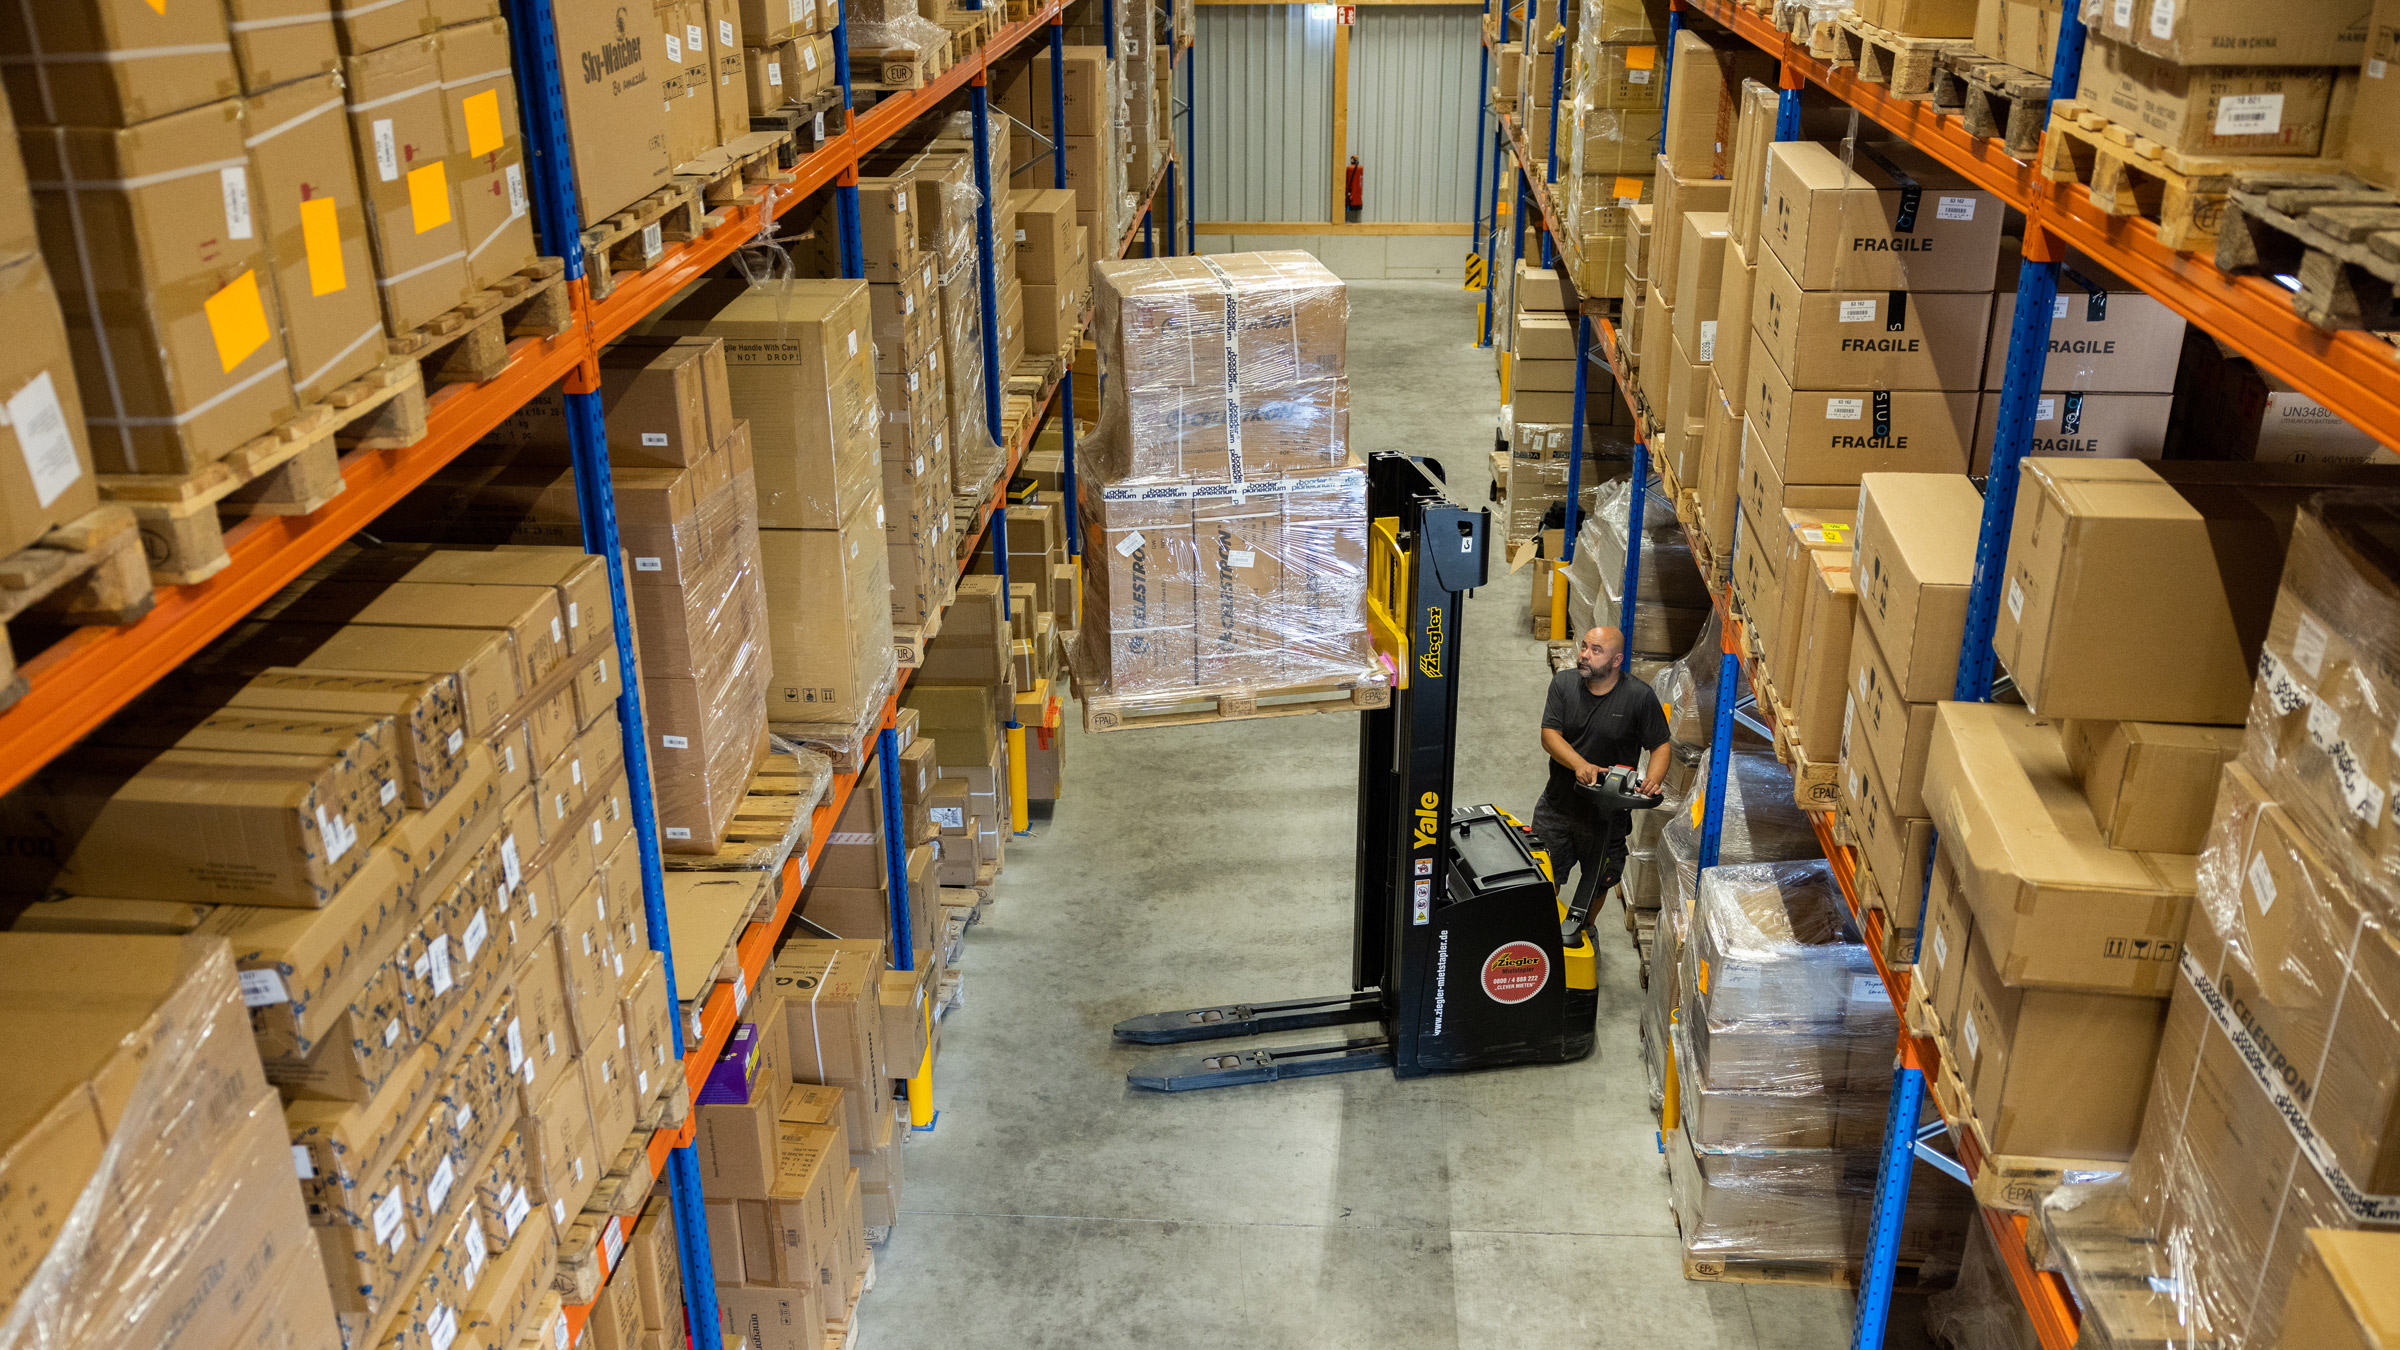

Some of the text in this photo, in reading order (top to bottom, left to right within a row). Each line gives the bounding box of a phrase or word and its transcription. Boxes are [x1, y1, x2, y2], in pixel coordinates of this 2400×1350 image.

[581, 36, 642, 85] Sky-Watcher
[890, 65, 908, 79] EUR
[1853, 238, 1933, 252] FRAGILE
[1841, 338, 1920, 352] FRAGILE
[2047, 340, 2116, 354] RAGILE
[737, 353, 799, 361] NOT DROP!
[2283, 406, 2332, 417] UN3480
[1831, 436, 1908, 449] FRAGILE
[2030, 438, 2098, 452] RAGILE
[1150, 486, 1179, 494] baader
[1199, 484, 1229, 493] baader
[1242, 485, 1286, 495] planetarium
[1249, 481, 1279, 490] baader
[1142, 490, 1187, 499] planetarium
[1192, 488, 1237, 498] planetarium
[1425, 606, 1443, 676] Ziegler
[1813, 787, 1838, 799] EPAL
[1413, 791, 1439, 850] Yale
[1497, 956, 1540, 967] Ziegler
[1433, 929, 1449, 1037] www.ziegler-mietstapler.de
[2233, 998, 2312, 1104] CELESTRON
[2007, 1187, 2034, 1201] EPA
